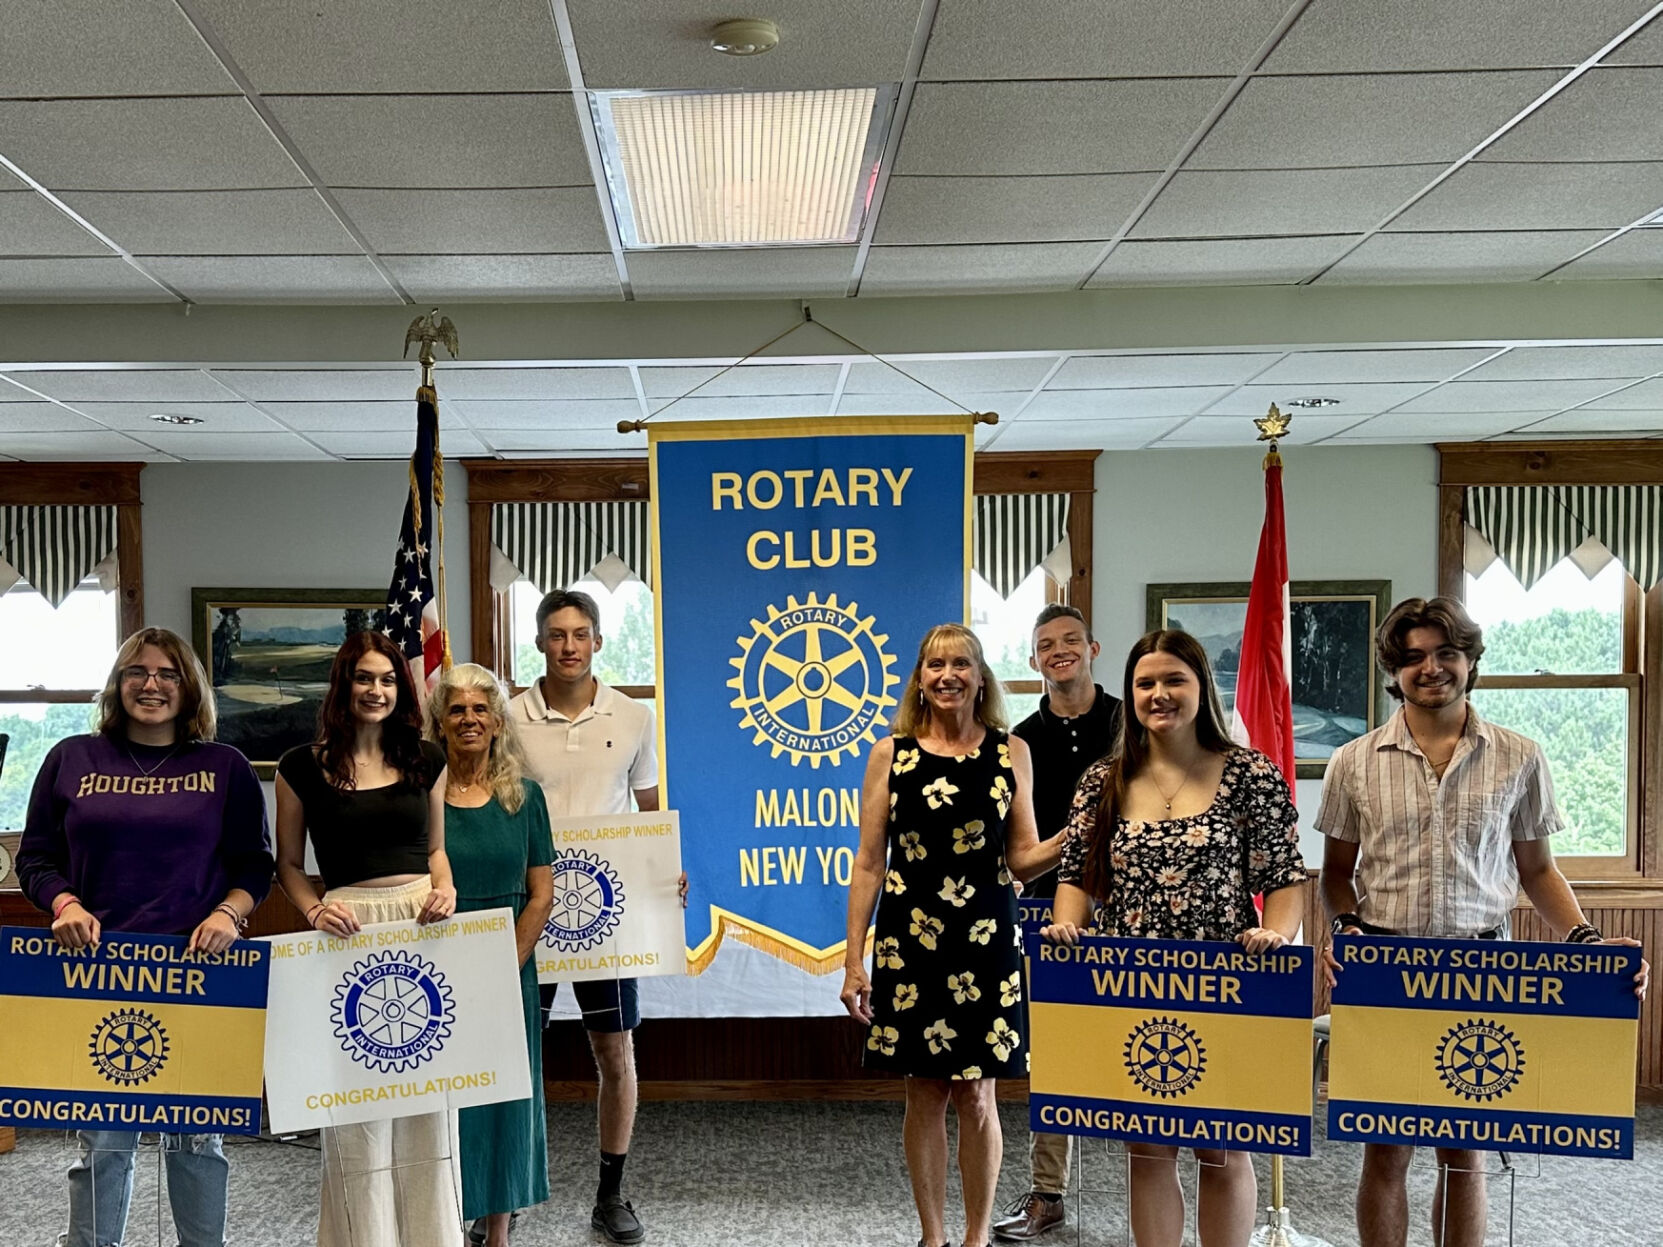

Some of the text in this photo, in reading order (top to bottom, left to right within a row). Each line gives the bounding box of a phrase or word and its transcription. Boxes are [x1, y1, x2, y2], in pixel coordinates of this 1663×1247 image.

[711, 467, 914, 511] ROTARY
[746, 528, 878, 571] CLUB
[779, 608, 848, 630] ROTARY
[753, 707, 875, 751] INTERNATIONAL
[76, 771, 216, 799] HOUGHTON
[755, 787, 860, 828] MALON
[562, 826, 632, 843] SCHOLARSHIP
[633, 823, 673, 837] WINNER
[739, 846, 855, 887] NEW YO
[271, 916, 507, 959] OME OF A ROTARY SCHOLARSHIP WINNER
[547, 912, 610, 940] TERNATIONAL
[106, 942, 262, 968] SCHOLARSHIP
[537, 952, 660, 974] GRATULATIONS!
[1040, 943, 1302, 975] ROTARY SCHOLARSHIP
[1343, 944, 1629, 976] ROTARY SCHOLARSHIP
[62, 962, 207, 996] WINNER
[365, 965, 415, 982] ROTARY
[1091, 968, 1243, 1004] WINNER
[1401, 970, 1565, 1006] WINNER
[114, 1016, 150, 1026] ROTARY
[1147, 1025, 1183, 1035] ROTARY
[1462, 1027, 1500, 1038] ROTARY
[355, 1023, 439, 1060] INTERNATIONAL
[100, 1058, 158, 1079] INTERNATIONAL
[1135, 1068, 1194, 1091] INTERNATIONAL
[1448, 1072, 1512, 1095] INTERNATIONAL
[306, 1071, 497, 1110] CONGRATULATIONS!
[0, 1098, 251, 1127] CONGRATULATIONS!
[1039, 1105, 1300, 1148] CONGRATULATIONS!
[1337, 1112, 1621, 1150] CONGRATULATIONS!
